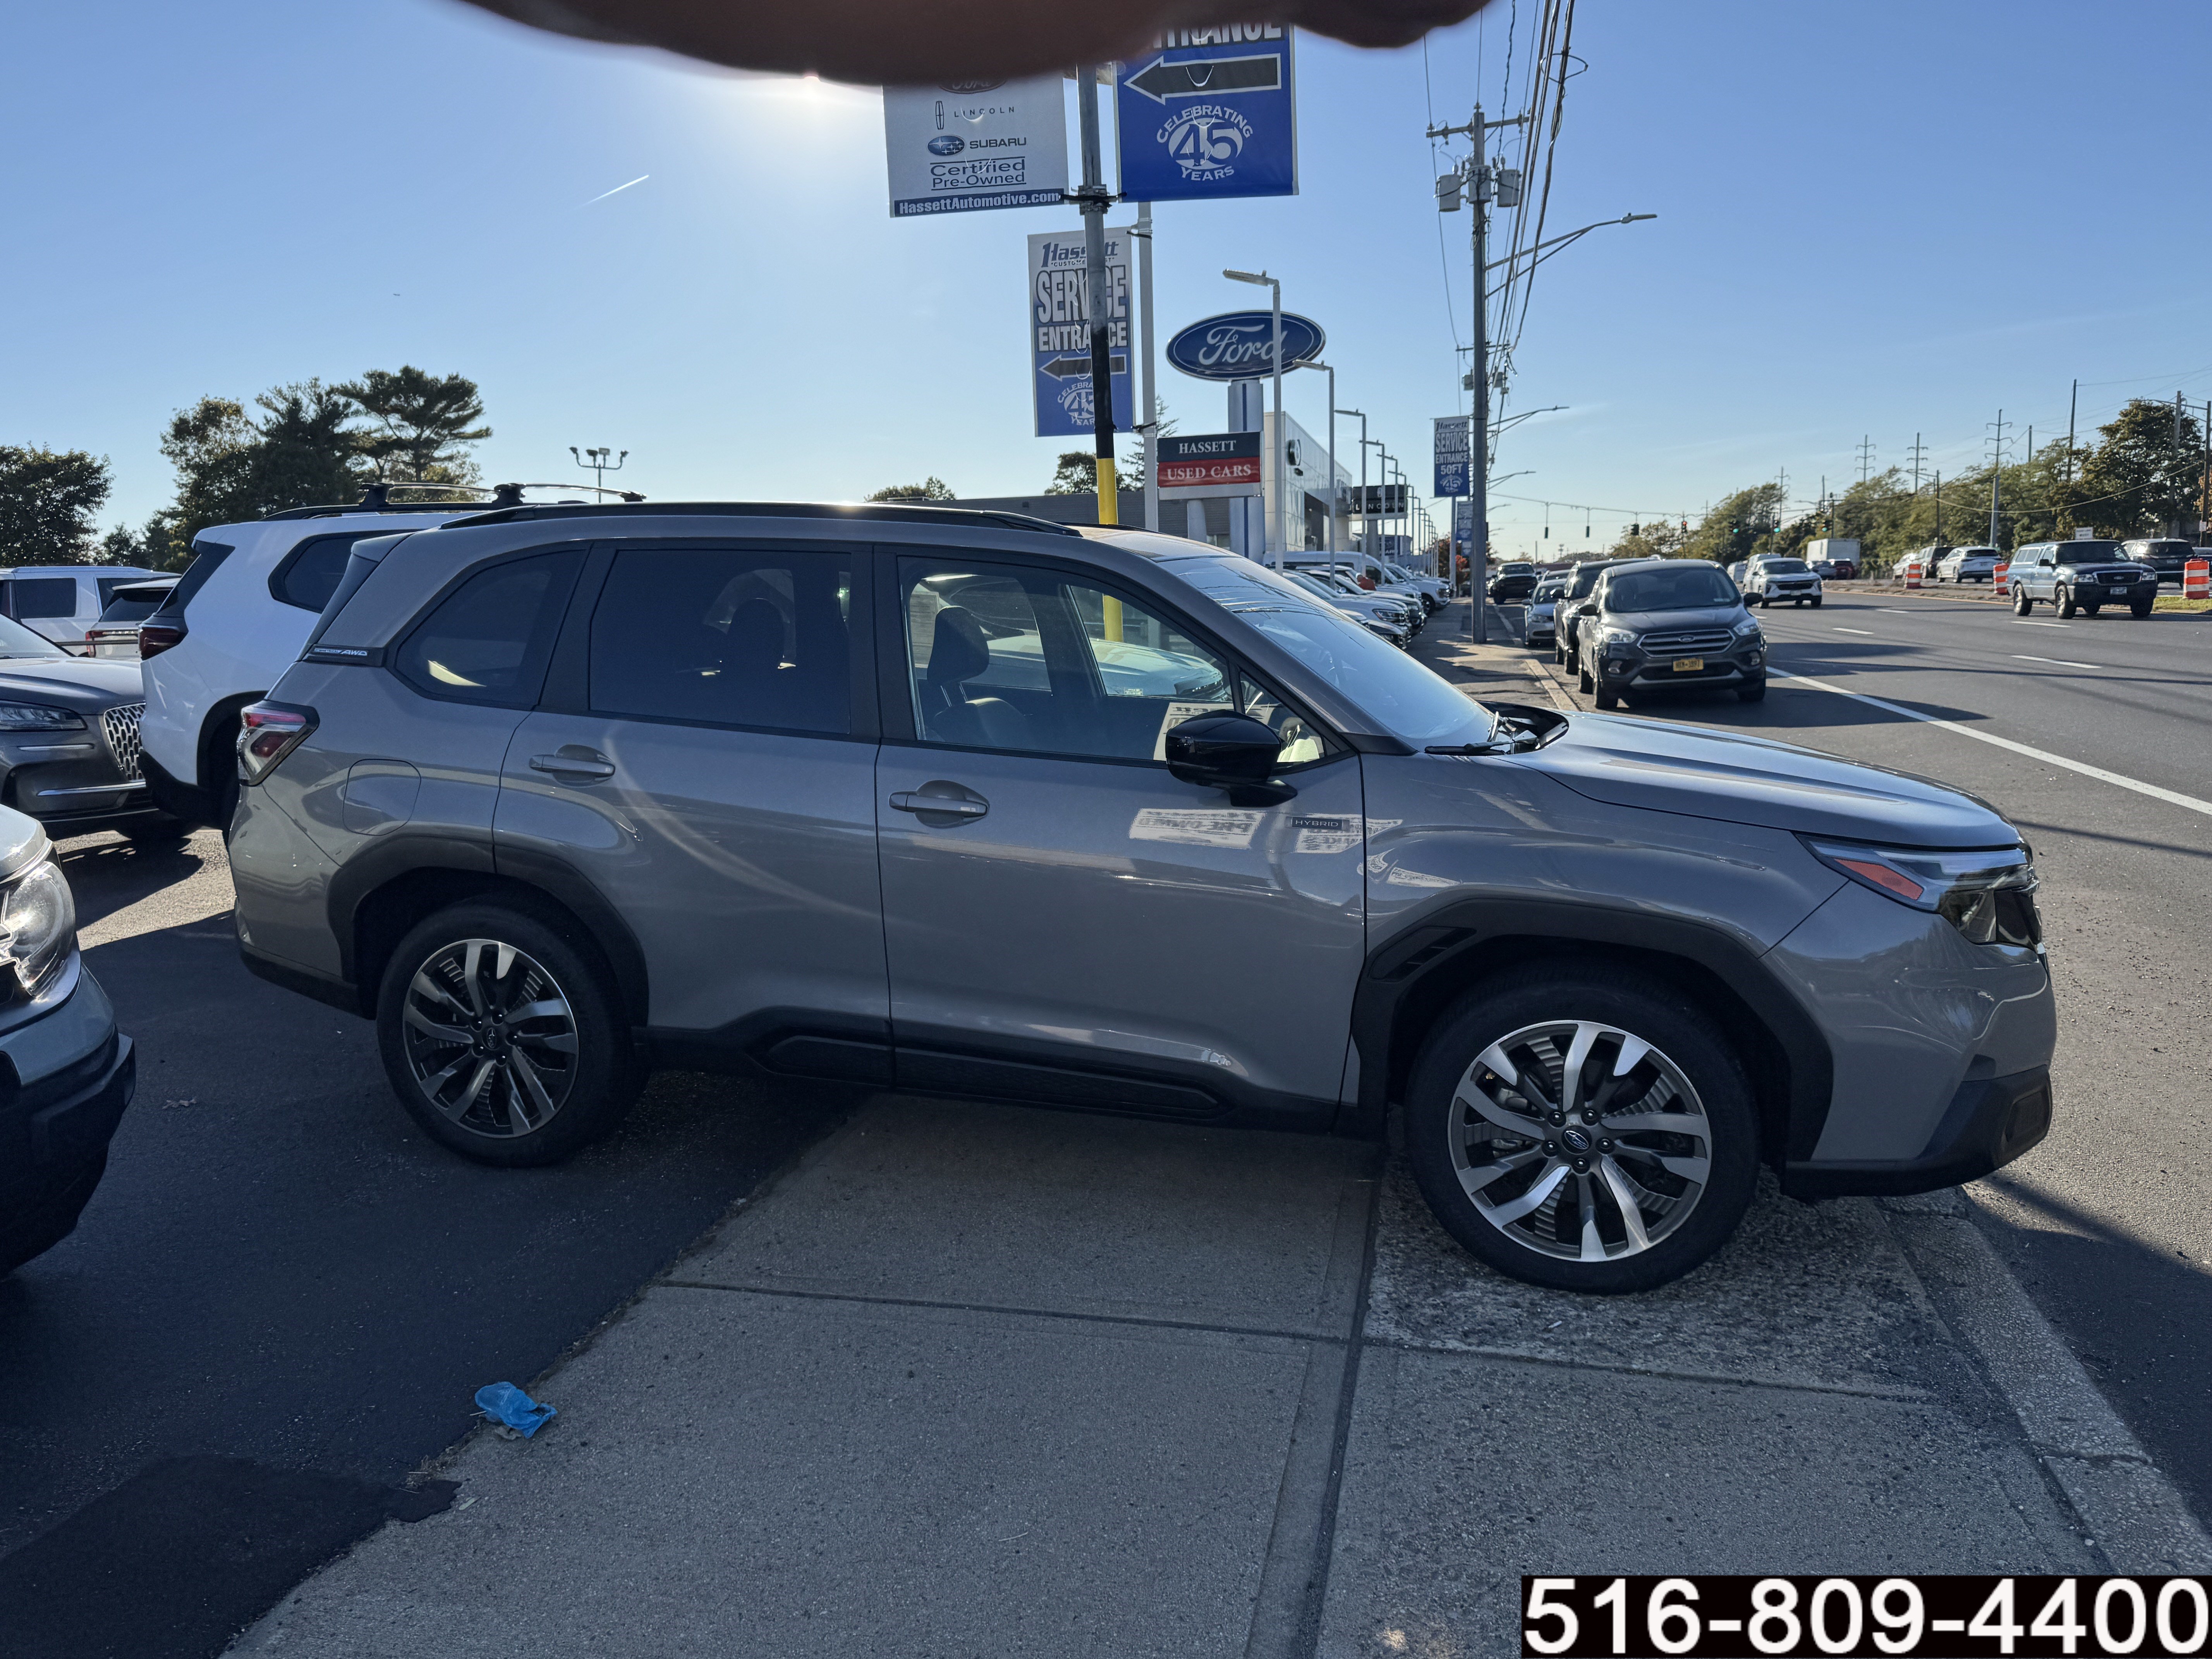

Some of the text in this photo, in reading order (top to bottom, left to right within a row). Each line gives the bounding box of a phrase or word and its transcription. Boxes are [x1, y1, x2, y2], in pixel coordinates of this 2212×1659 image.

[954, 106, 1014, 117] LINCOLN
[1157, 105, 1253, 143] CELEBRATING
[970, 137, 1026, 149] SUBARU
[1173, 122, 1238, 166] 45
[931, 159, 1025, 176] Certified
[1182, 165, 1234, 181] YEARS
[933, 172, 1024, 188] Pre-Owned
[900, 192, 1060, 214] HassettAutomotive.com
[1041, 241, 1119, 268] Hastt
[1036, 265, 1126, 323] SERVE
[1038, 321, 1127, 351] ENTRACE
[1199, 325, 1288, 365] Ford
[1071, 417, 1095, 426] YEAR
[1179, 440, 1236, 454] HASSETT
[1436, 431, 1468, 453] SERVICE
[1436, 452, 1468, 464] ENTRANCE
[1167, 464, 1251, 480] USED CARS
